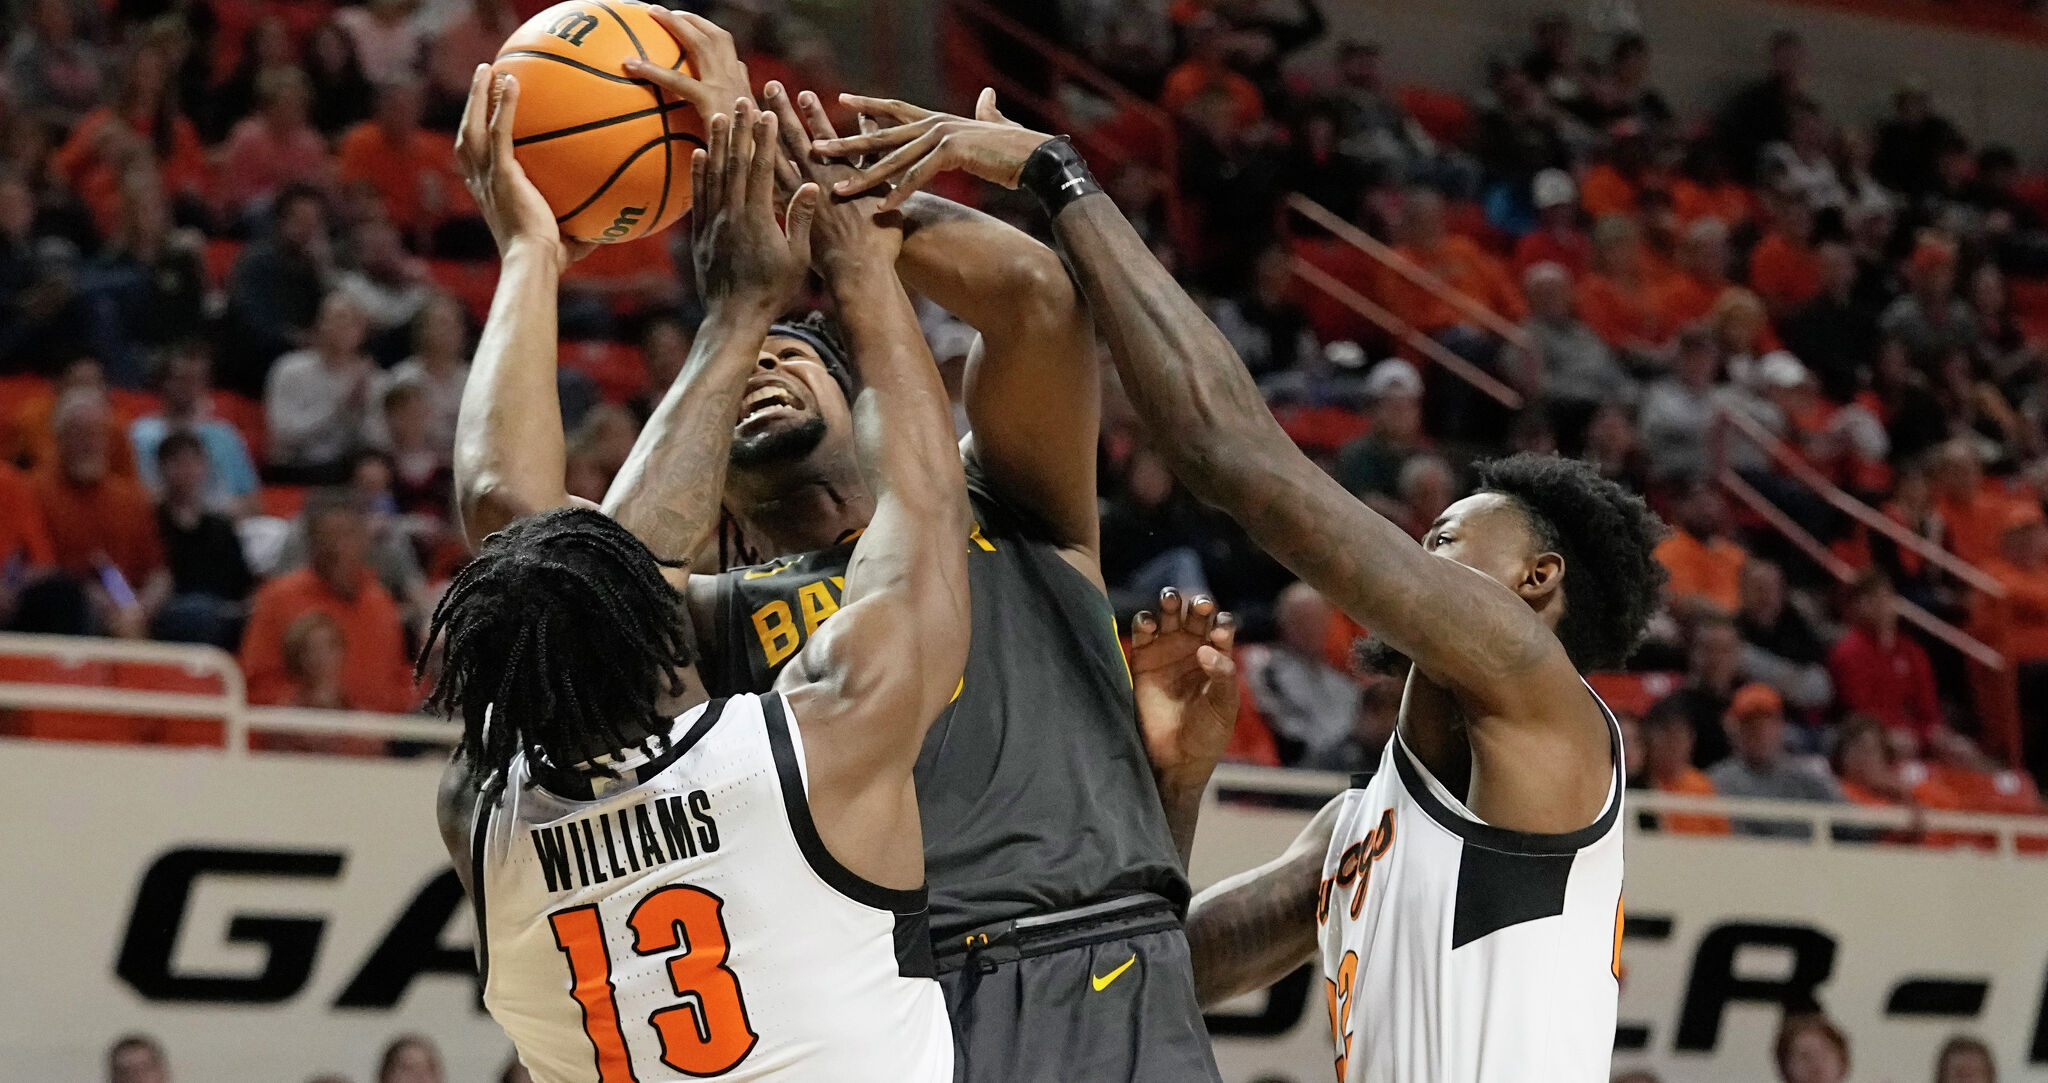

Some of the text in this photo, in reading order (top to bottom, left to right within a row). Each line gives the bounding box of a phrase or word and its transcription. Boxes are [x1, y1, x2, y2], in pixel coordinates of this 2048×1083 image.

[531, 790, 720, 892] WILLIAMS
[116, 846, 492, 1014] GA
[548, 883, 759, 1083] 13
